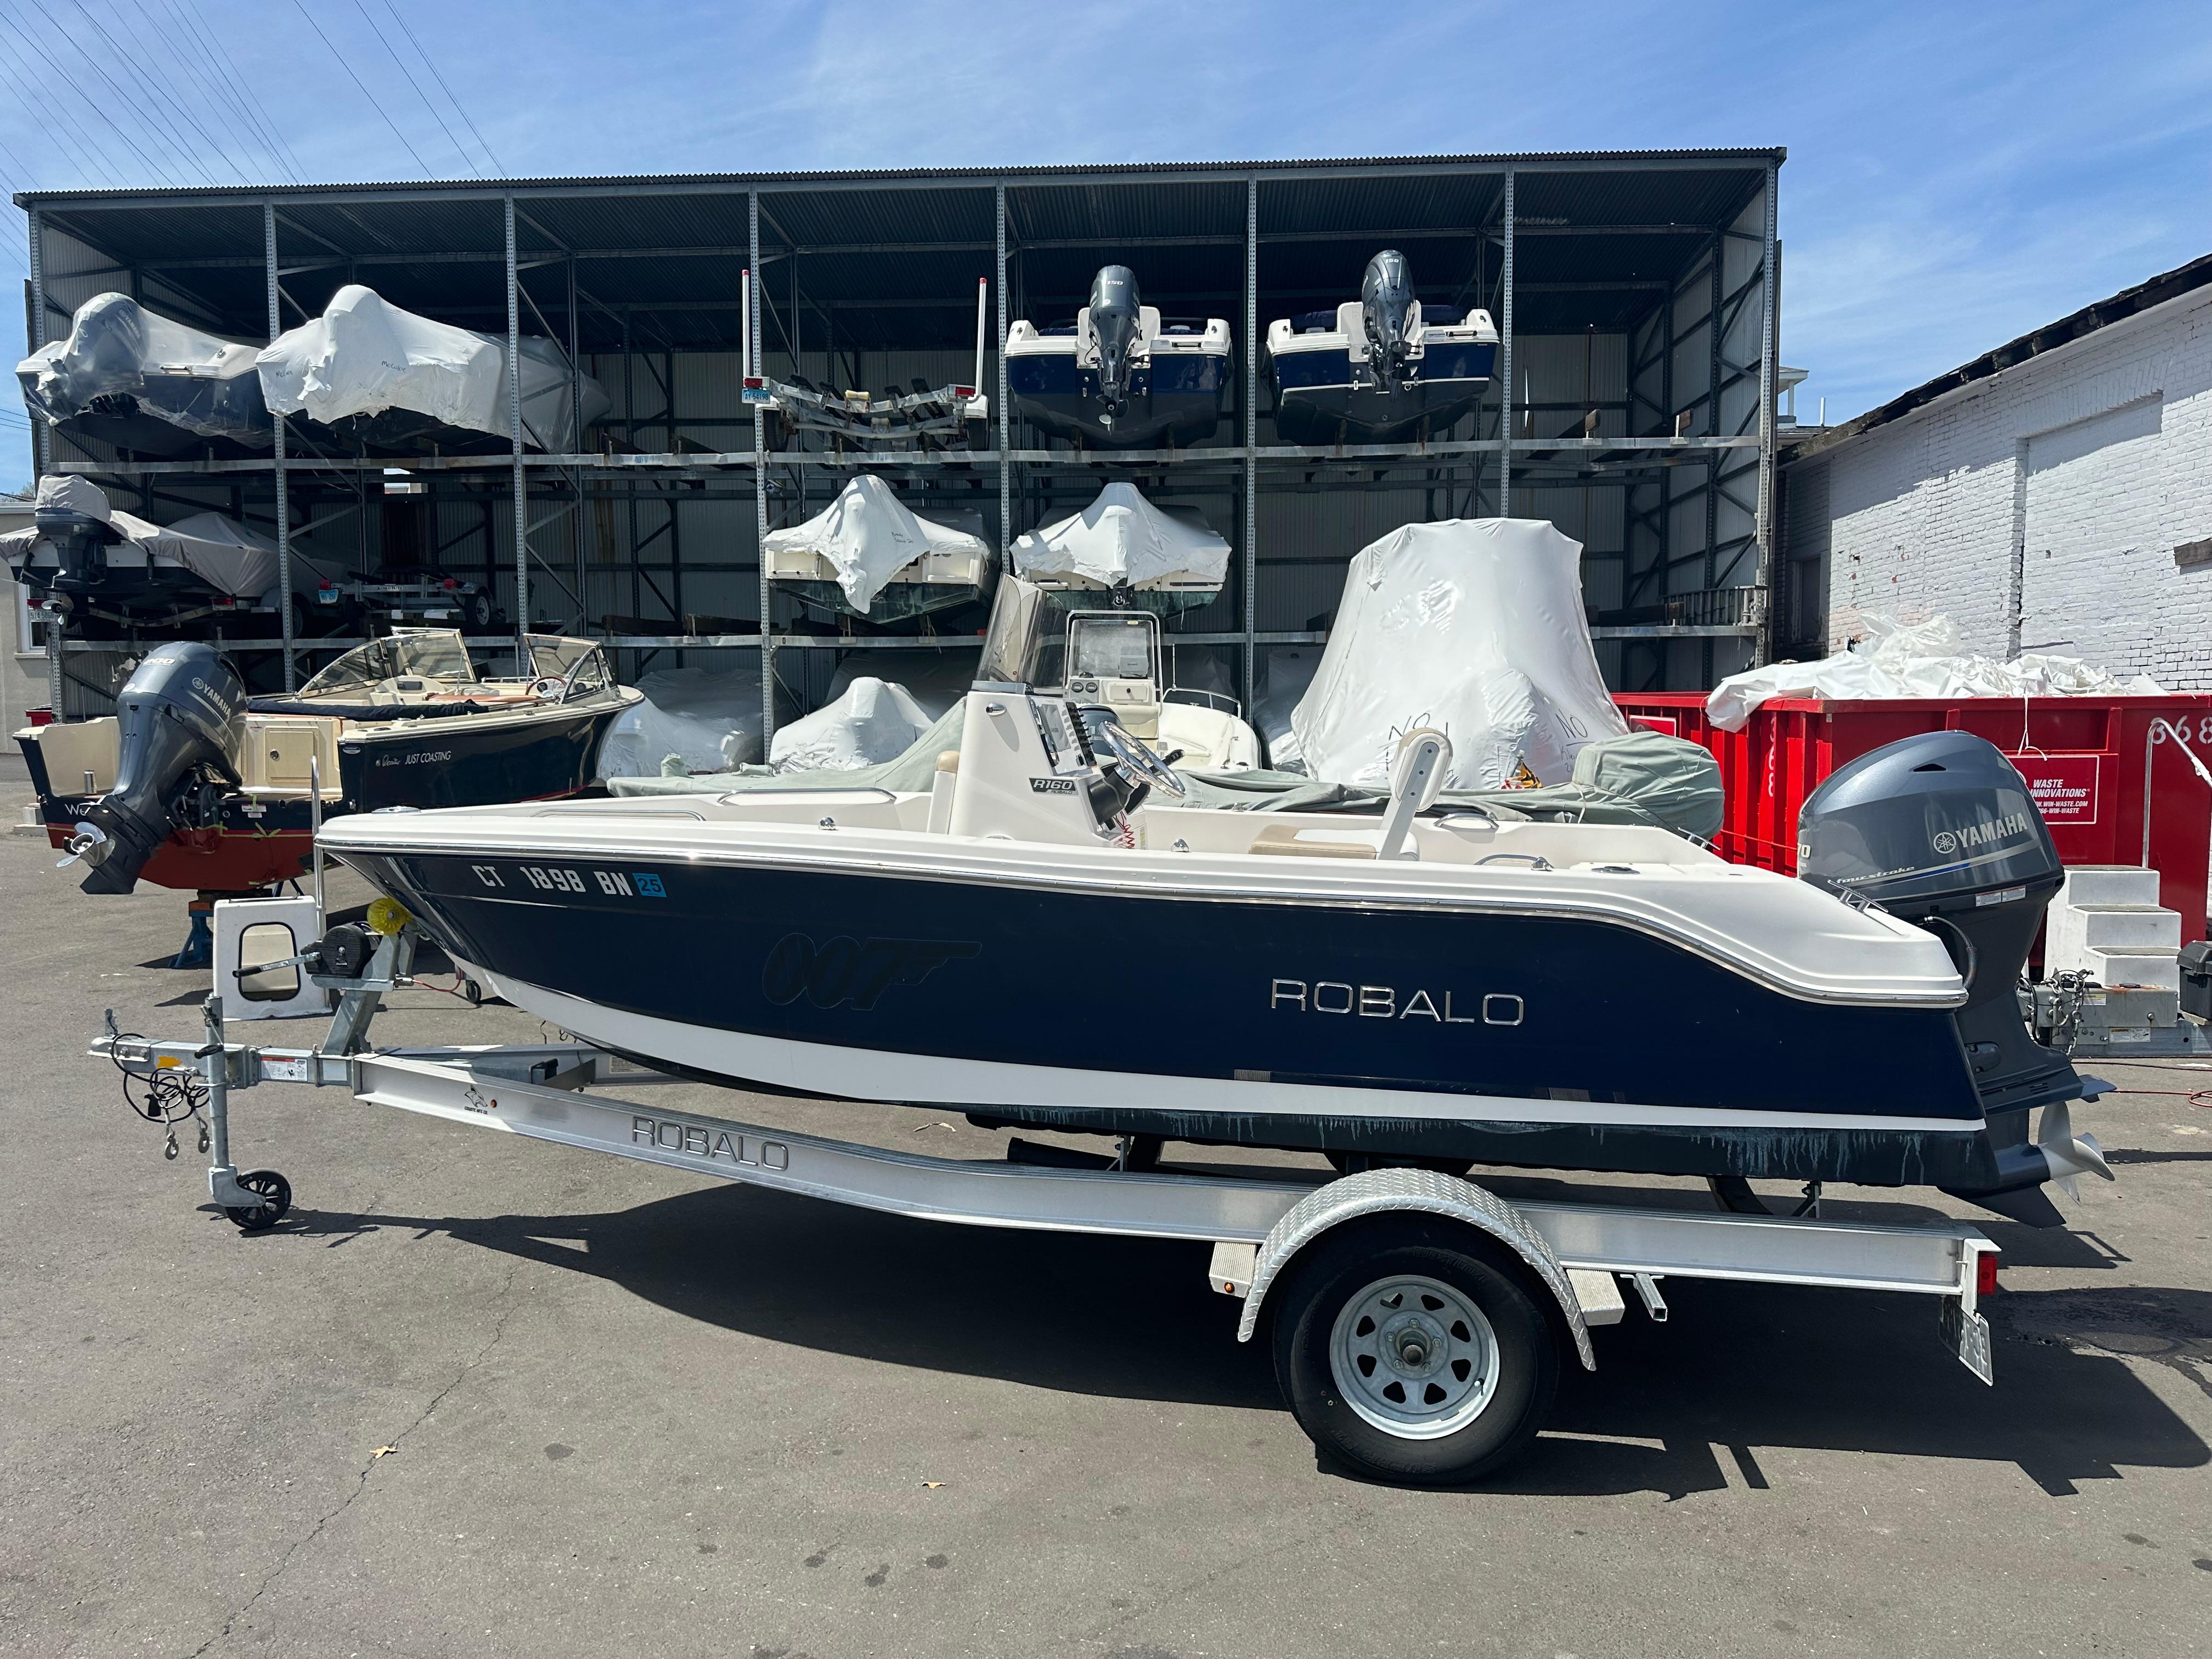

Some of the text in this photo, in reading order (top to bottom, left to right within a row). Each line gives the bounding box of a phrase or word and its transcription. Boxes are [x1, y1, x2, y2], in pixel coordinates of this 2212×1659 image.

[203, 683, 233, 718] YAMAHA
[1554, 708, 1588, 738] NO
[404, 753, 420, 765] JUST
[420, 750, 452, 764] COASTING
[1033, 780, 1073, 790] R160
[2033, 779, 2064, 788] WASTE
[1955, 812, 2028, 848] YAMAHA
[471, 865, 634, 896] CT 1898 BN
[637, 878, 663, 892] 25
[1271, 978, 1524, 1026] ROBALO
[632, 1116, 789, 1171] ROBALO
